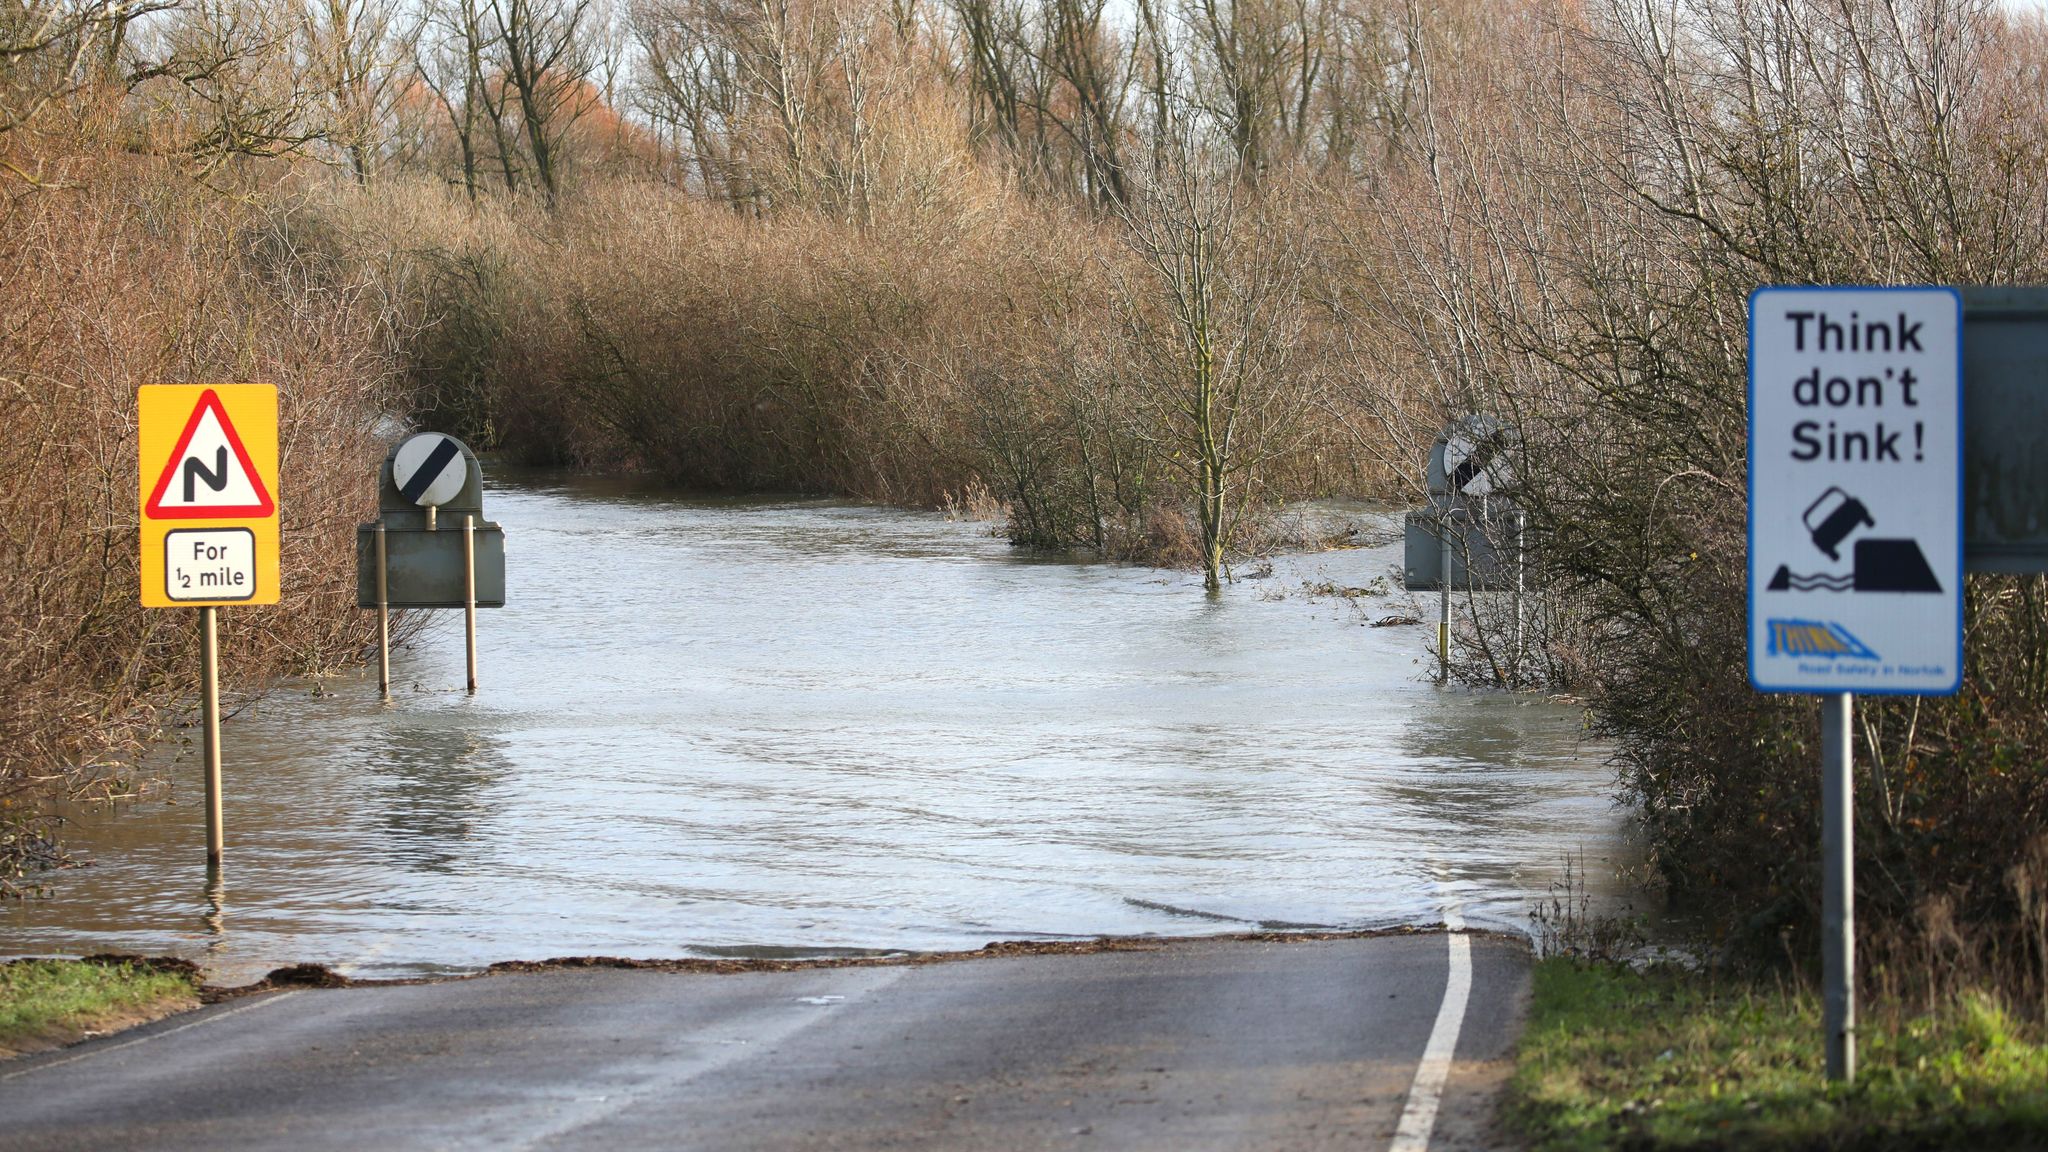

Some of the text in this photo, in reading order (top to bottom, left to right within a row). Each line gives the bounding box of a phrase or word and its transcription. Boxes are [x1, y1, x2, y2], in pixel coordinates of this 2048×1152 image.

[1786, 312, 1924, 352] Think
[1793, 367, 1918, 407] don't
[193, 541, 228, 560] For
[200, 566, 244, 587] mile
